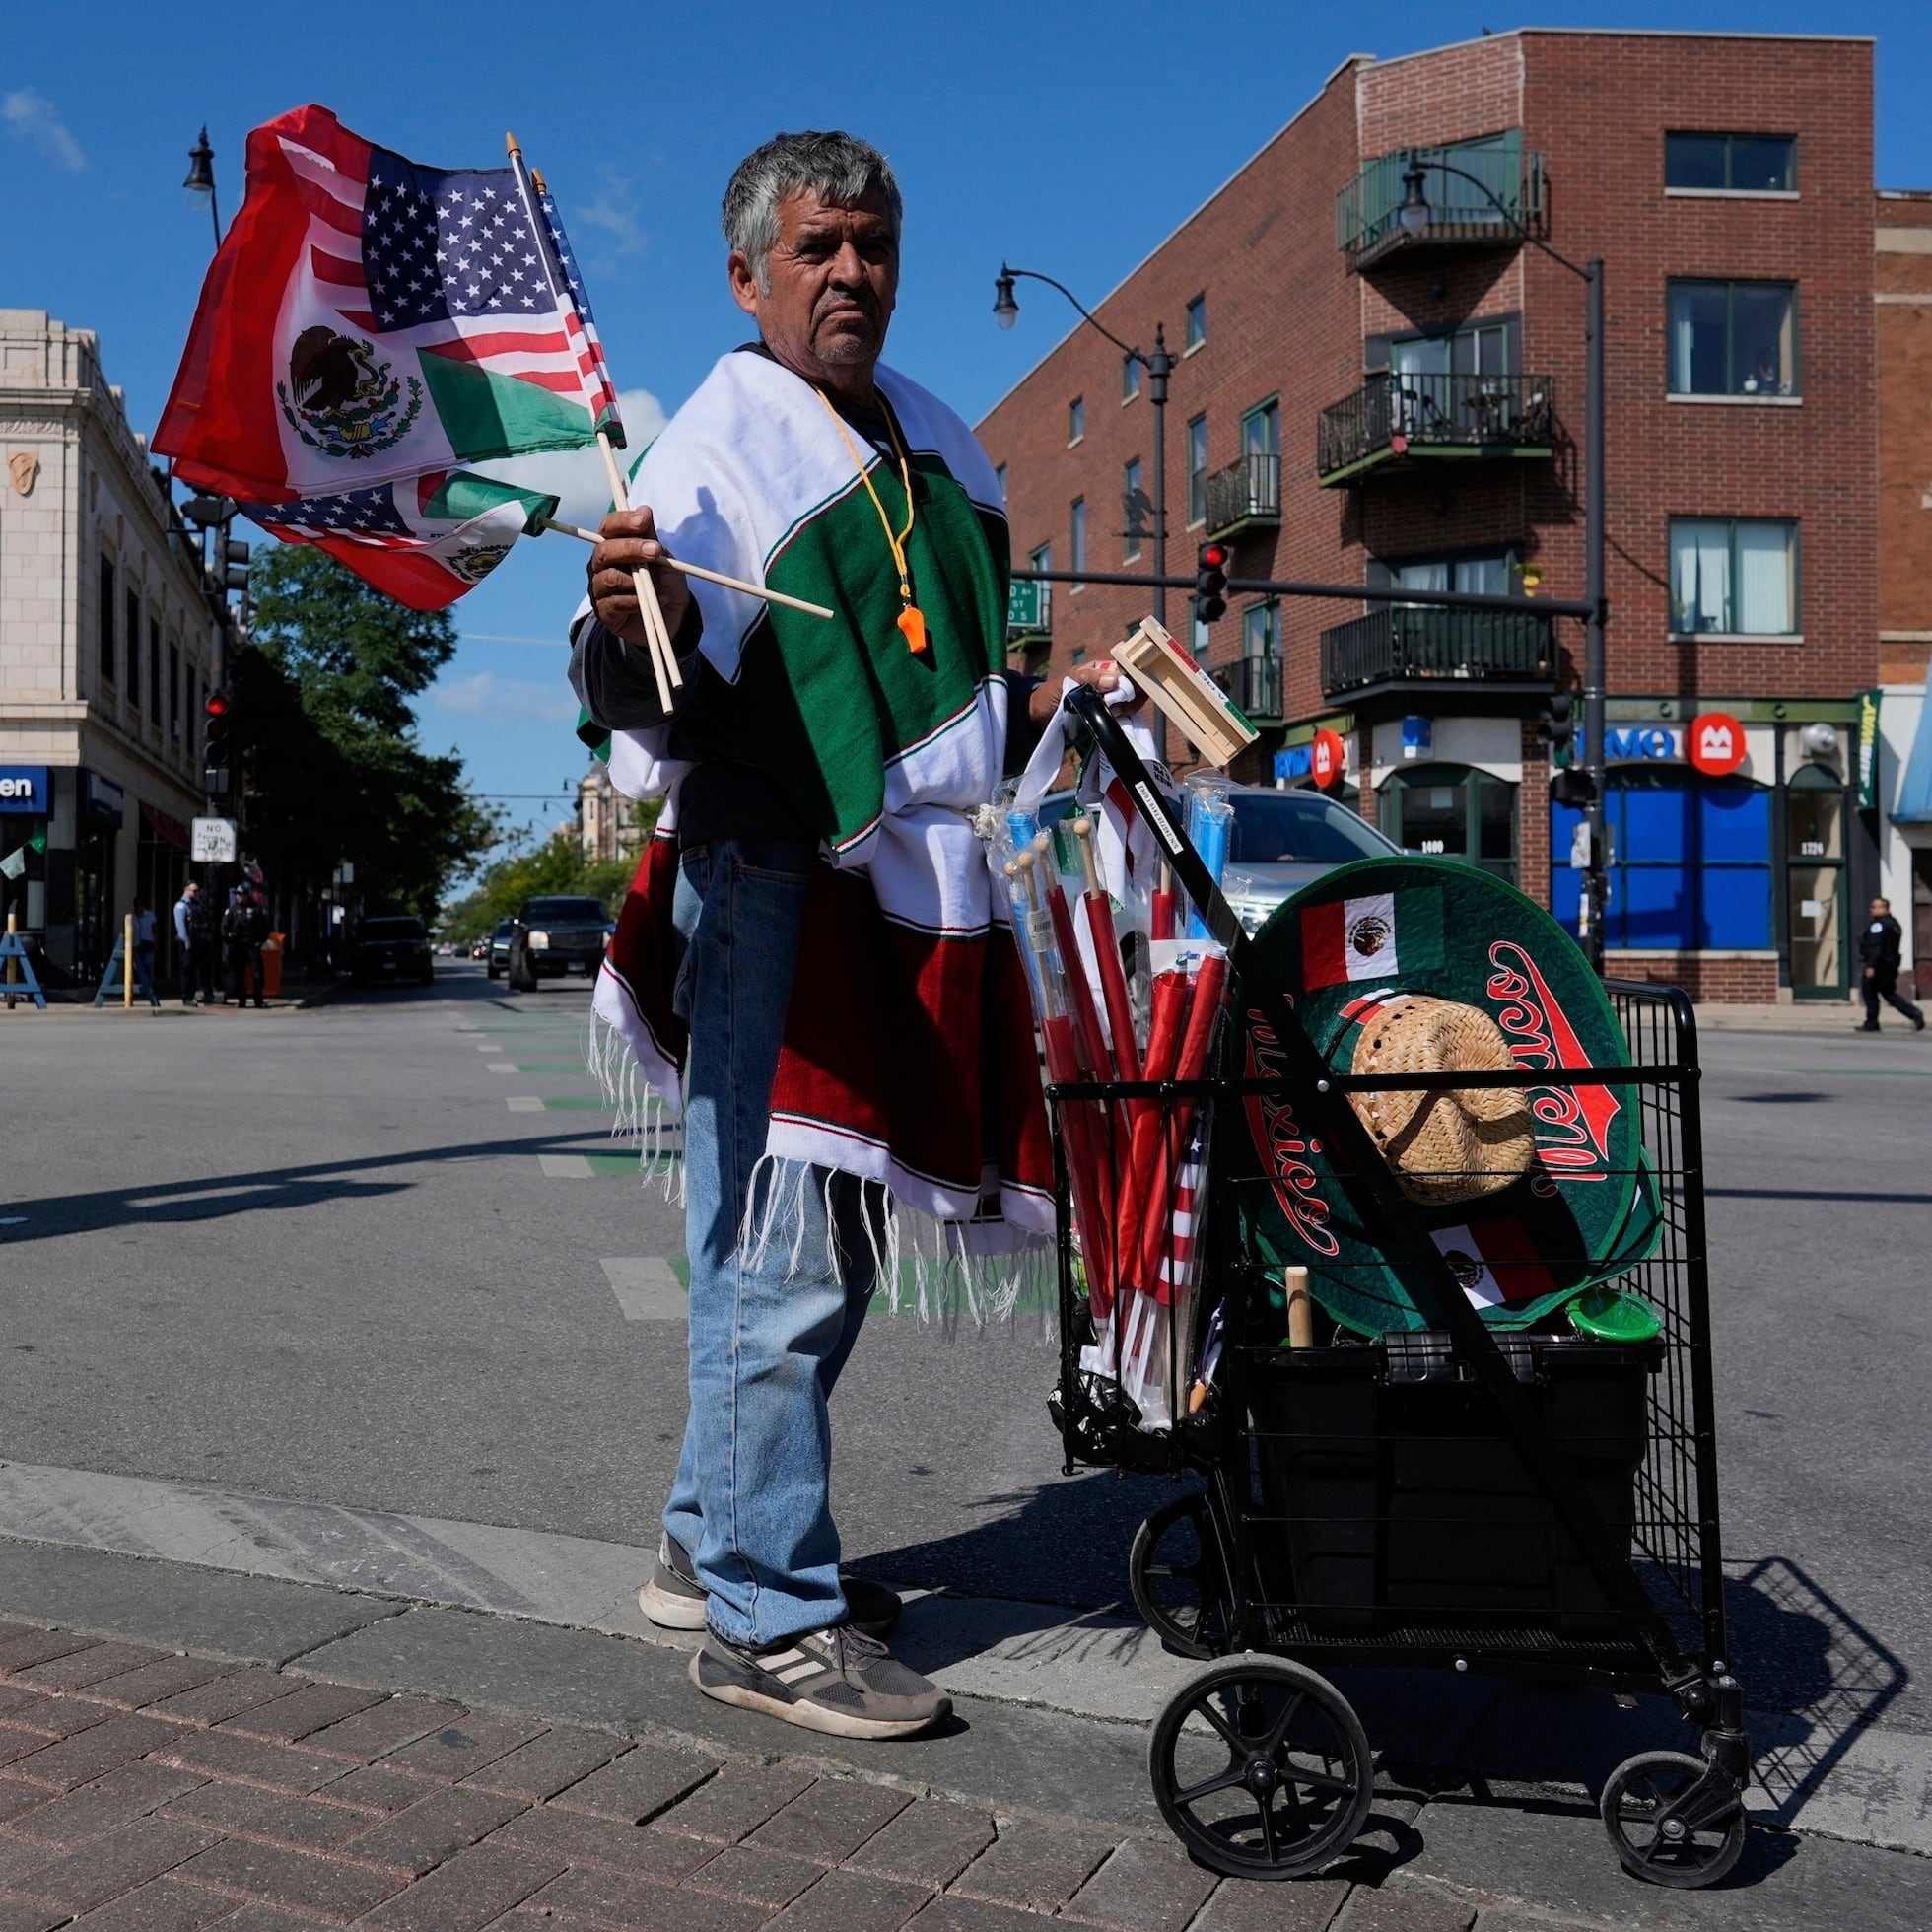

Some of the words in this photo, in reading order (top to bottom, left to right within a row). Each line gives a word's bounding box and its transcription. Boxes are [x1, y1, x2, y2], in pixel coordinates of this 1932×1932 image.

[1859, 694, 1877, 805] SUBWAY
[0, 778, 32, 797] en
[207, 824, 222, 833] NO
[1486, 940, 1622, 1198] Meico
